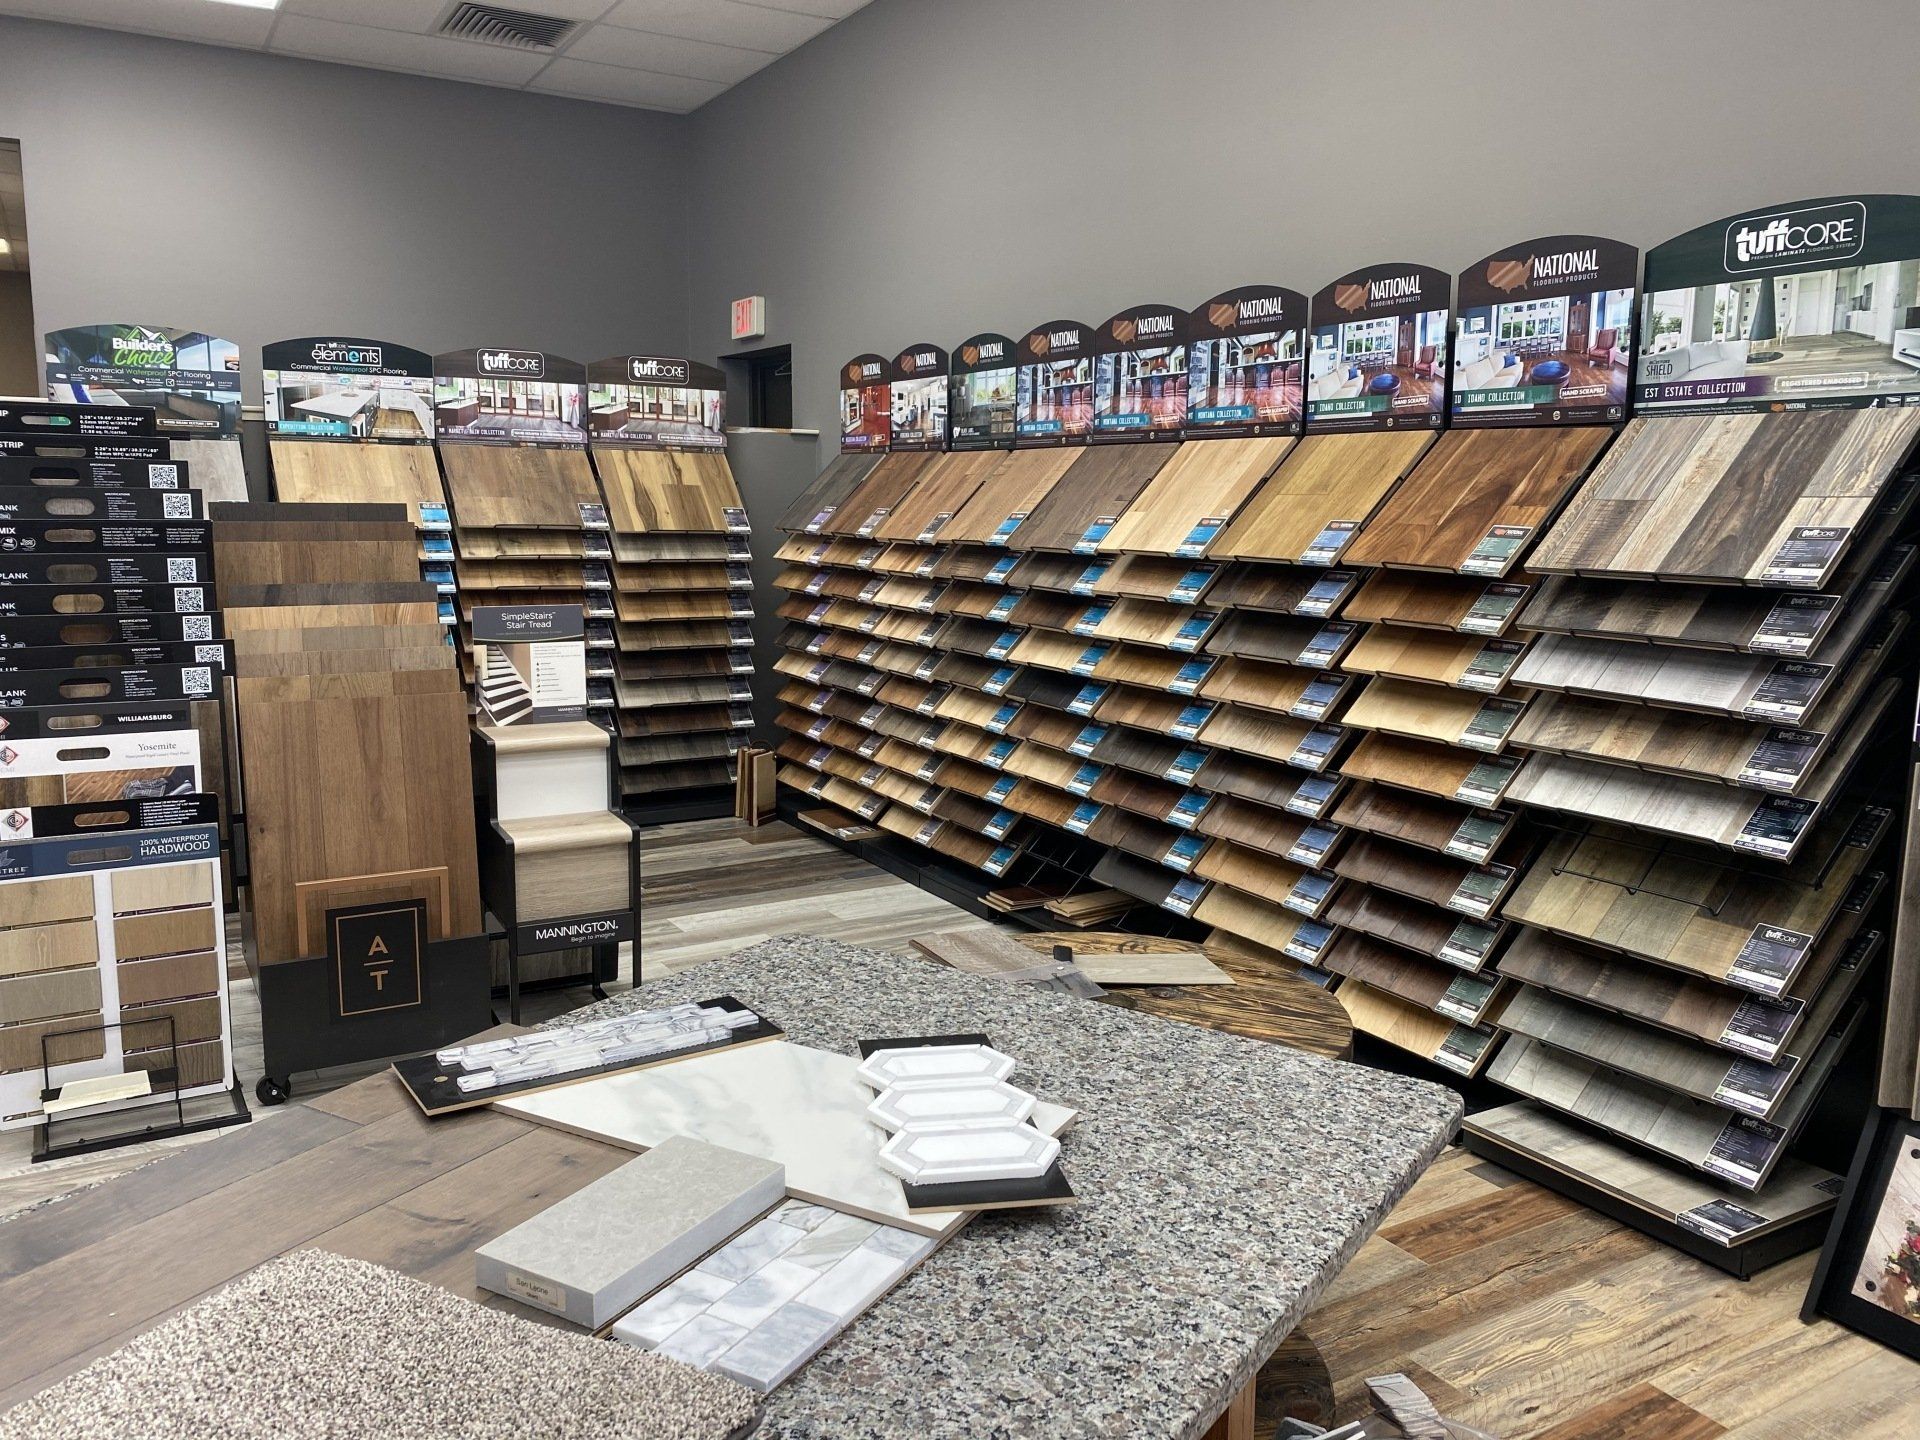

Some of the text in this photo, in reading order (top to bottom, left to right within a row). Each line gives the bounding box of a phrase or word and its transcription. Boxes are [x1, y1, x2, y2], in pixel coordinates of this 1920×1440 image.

[1736, 218, 1855, 262] tuffCORE
[1775, 249, 1805, 258] LAMINATE
[1533, 249, 1599, 278] NATIONAL
[1533, 272, 1598, 287] FLOORING PRODUCTS
[1371, 275, 1422, 300] NATIONAL
[1240, 296, 1283, 319] NATIONAL
[1371, 296, 1421, 308] FLOORING PRODUCTS
[1138, 315, 1174, 334] NATIONAL
[1261, 315, 1282, 323] PRODUCTS
[113, 338, 173, 352] Builder's
[1050, 329, 1080, 348] NATIONAL
[311, 347, 379, 363] elements
[979, 342, 1004, 358] NATIONAL
[114, 349, 175, 366] Choice
[482, 352, 539, 371] tuffCORE
[916, 352, 937, 365] NATIONAL
[78, 366, 124, 375] Commercial
[124, 368, 166, 377] Waterproof
[184, 371, 211, 380] Flooring
[291, 362, 331, 371] Commercial
[333, 365, 368, 374] Waterproof
[383, 368, 407, 376] Flooring
[633, 360, 684, 378] tuffCORE
[863, 362, 881, 375] NATIONAL
[1646, 364, 1673, 377] SHIELD
[1781, 377, 1862, 387] REGISTERED EMBOSSED
[1455, 391, 1525, 403] ID IDAHO COLLECTION
[1562, 389, 1577, 397] HAND
[1645, 382, 1746, 398] EST ESTATE COLLECTION
[1336, 401, 1365, 410] COLLECTION
[1217, 409, 1242, 417] COLLECTION
[506, 620, 552, 629] Stair Tread
[118, 714, 173, 722] WILLIAMSBURG
[138, 742, 177, 751] Yosemite
[140, 834, 210, 847] 100% WATERPROOF
[140, 840, 211, 856] HARDWOOD
[368, 935, 389, 956] A
[571, 934, 587, 943] Begin
[370, 970, 389, 991] T
[516, 1278, 529, 1288] San
